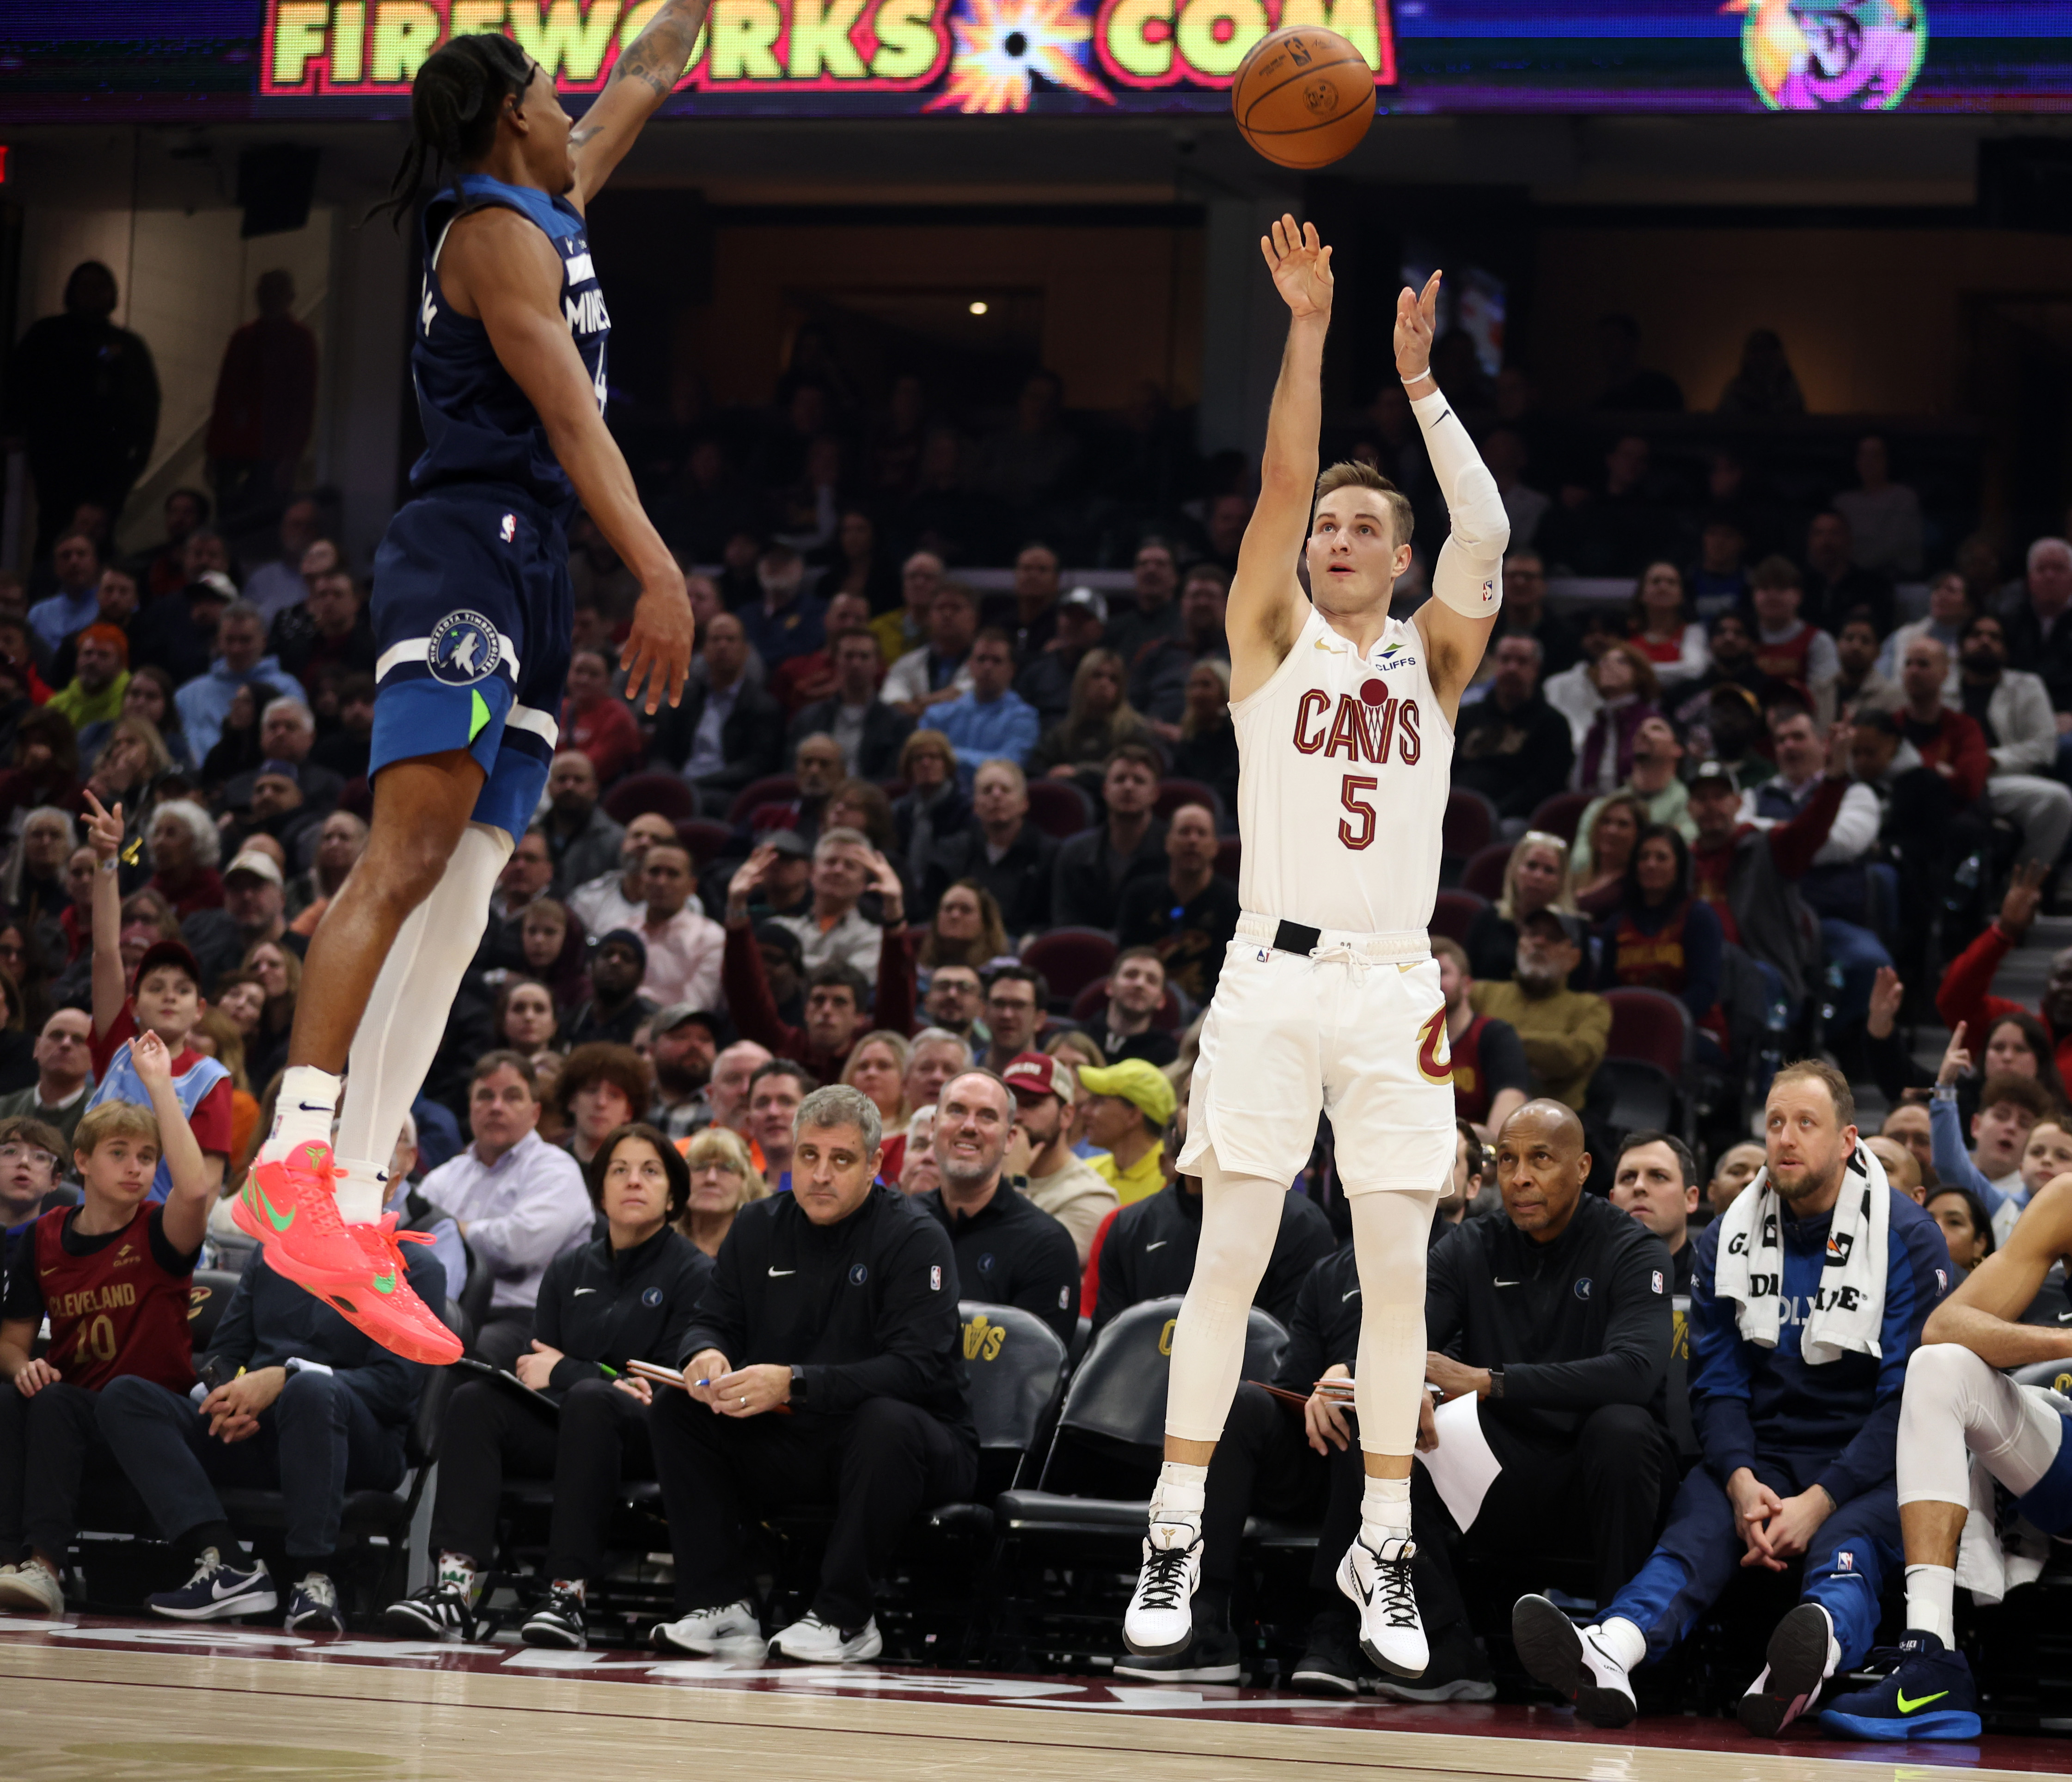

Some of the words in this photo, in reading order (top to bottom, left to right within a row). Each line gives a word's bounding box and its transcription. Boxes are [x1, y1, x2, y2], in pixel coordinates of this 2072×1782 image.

[271, 0, 940, 82] FIRWRKS
[430, 615, 461, 664] MINNESOTA
[464, 613, 498, 674] TIMBERWOLVES
[1375, 657, 1416, 671] CLIFFS
[1293, 689, 1421, 765] CAVS
[1338, 774, 1378, 850] 5
[49, 1282, 136, 1317] CLEVELAND
[74, 1314, 116, 1363] 10
[0, 1612, 1387, 1711] etway
